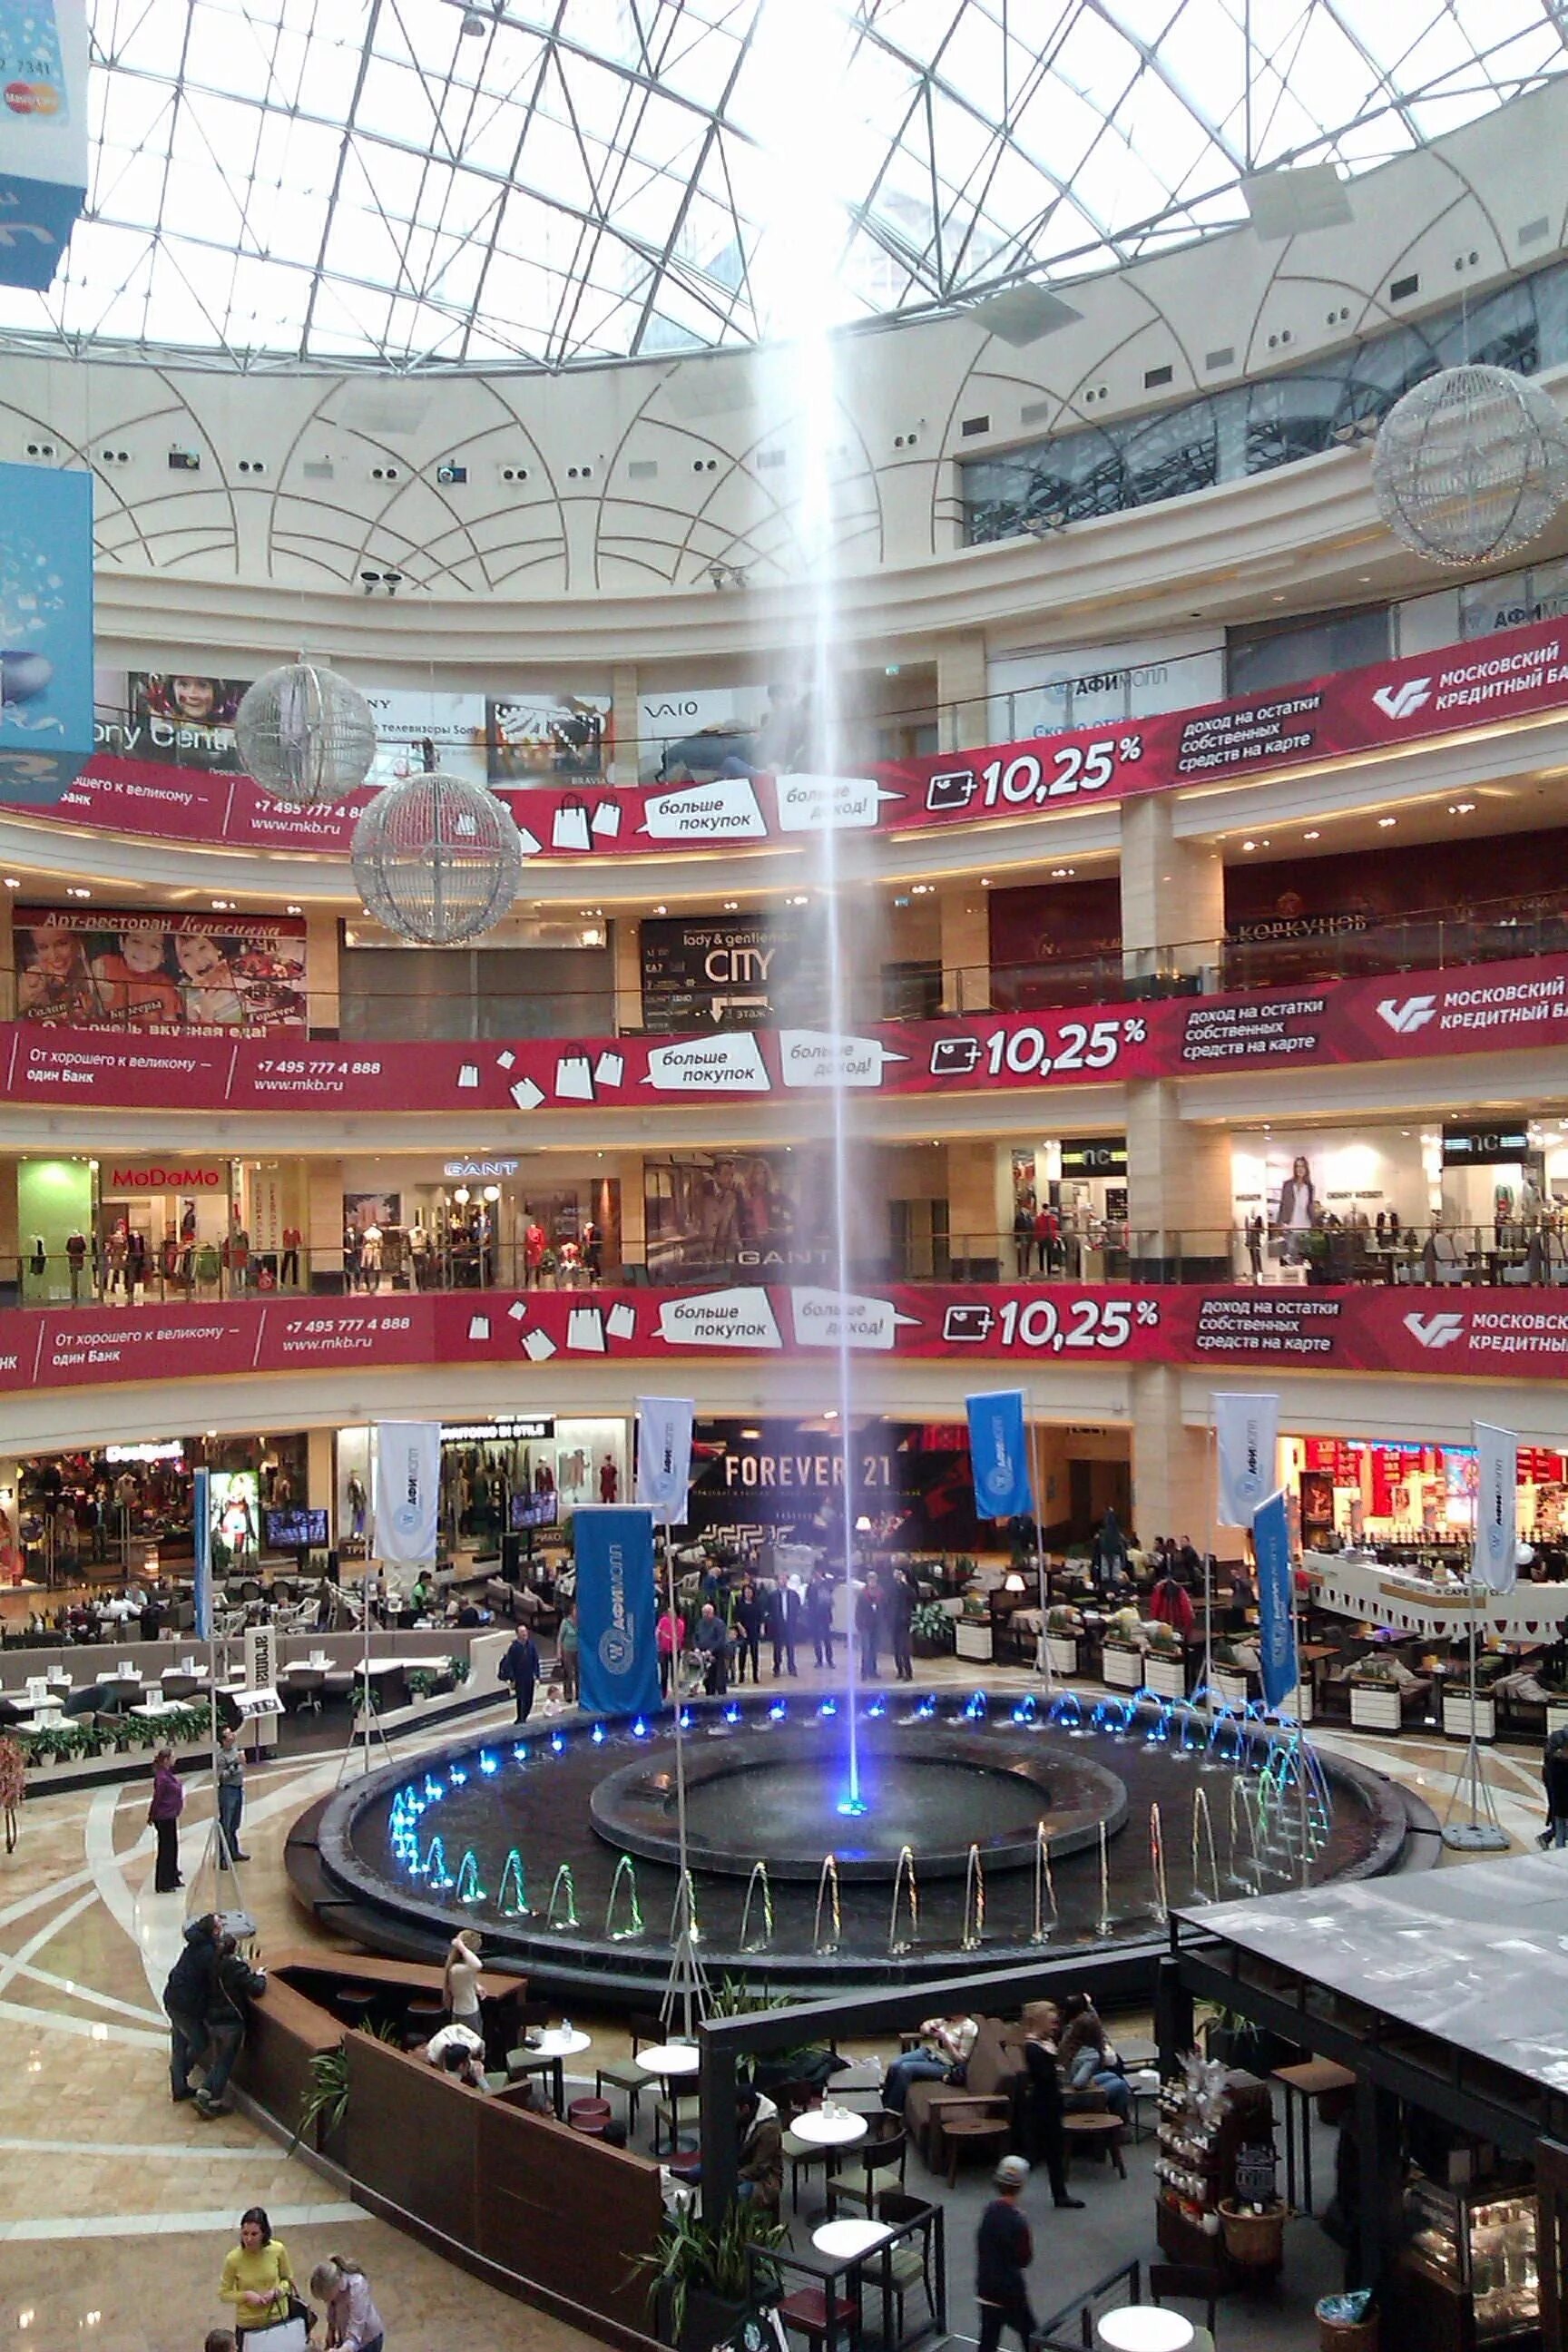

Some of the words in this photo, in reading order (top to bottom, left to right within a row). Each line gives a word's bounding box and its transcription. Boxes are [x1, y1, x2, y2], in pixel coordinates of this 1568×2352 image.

[1439, 641, 1560, 688] МОСКОВСКИЙ
[1436, 668, 1544, 710] КРЕДИТНЫЙ
[644, 701, 698, 718] VAIO
[1183, 716, 1231, 738] доход
[1235, 712, 1253, 725] на
[1257, 696, 1320, 720] остатки
[382, 724, 451, 736] телевизоры
[1181, 723, 1280, 753] собственных
[1179, 749, 1240, 772] средств
[1243, 744, 1262, 758] на
[1265, 733, 1311, 753] карте
[114, 783, 123, 792] к
[127, 782, 192, 806] великому
[255, 799, 270, 812] +7
[273, 801, 301, 815] 495
[335, 806, 346, 818] 4
[659, 799, 724, 815] больше
[250, 818, 342, 835] www.mkb.ru
[679, 814, 751, 831] покупок
[44, 912, 172, 933] Арт-ресторан
[683, 933, 711, 948] lady
[713, 933, 723, 946] &
[704, 948, 777, 983] CITY
[1444, 975, 1565, 1007] МОСКОВСКИЙ
[1188, 1008, 1237, 1026] доход
[1239, 1005, 1258, 1018] на
[1260, 999, 1324, 1017] остатки
[1440, 1000, 1550, 1029] КРЕДИТНЫЙ
[229, 1026, 267, 1040] еда!
[1185, 1021, 1285, 1042] собственных
[1182, 1042, 1244, 1061] средств
[1247, 1040, 1267, 1053] на
[1269, 1034, 1316, 1054] карте
[30, 1048, 47, 1063] От
[50, 1053, 116, 1069] хорошего
[117, 1057, 127, 1067] к
[129, 1057, 197, 1073] великому
[662, 1050, 728, 1066] больше
[26, 1069, 59, 1084] один
[62, 1069, 94, 1084] Банк
[256, 1061, 272, 1073] +7
[276, 1061, 305, 1074] 495
[309, 1062, 336, 1075] 777
[338, 1062, 348, 1074] 4
[351, 1062, 381, 1075] 888
[682, 1066, 756, 1083] покупок
[254, 1077, 344, 1092] www.mkb.ru
[113, 1168, 219, 1187] MoDaMo
[444, 1161, 519, 1176] GANT
[738, 1250, 833, 1266] GANT
[673, 1304, 740, 1320] больше
[1201, 1300, 1251, 1316] доход
[1254, 1301, 1273, 1314] на
[1276, 1301, 1340, 1315] остатки
[286, 1319, 302, 1333] +7
[305, 1319, 334, 1333] 495
[338, 1318, 364, 1333] 777
[367, 1318, 378, 1331] 4
[381, 1317, 410, 1331] 888
[693, 1321, 767, 1337] покупок
[1199, 1316, 1300, 1333] собственных
[55, 1333, 73, 1347] От
[75, 1330, 142, 1347] хорошего
[144, 1331, 154, 1341] к
[156, 1325, 223, 1343] великому
[282, 1336, 372, 1352] www.mkb.ru
[1196, 1335, 1259, 1351] средств
[1262, 1337, 1282, 1349] на
[1285, 1337, 1331, 1353] карте
[1468, 1334, 1568, 1353] КРЕДИТНЫ
[52, 1352, 85, 1367] один
[88, 1349, 122, 1363] Банк
[725, 1455, 846, 1486] FOREVER
[863, 1455, 891, 1486] 21
[254, 1635, 270, 1683] aroma
